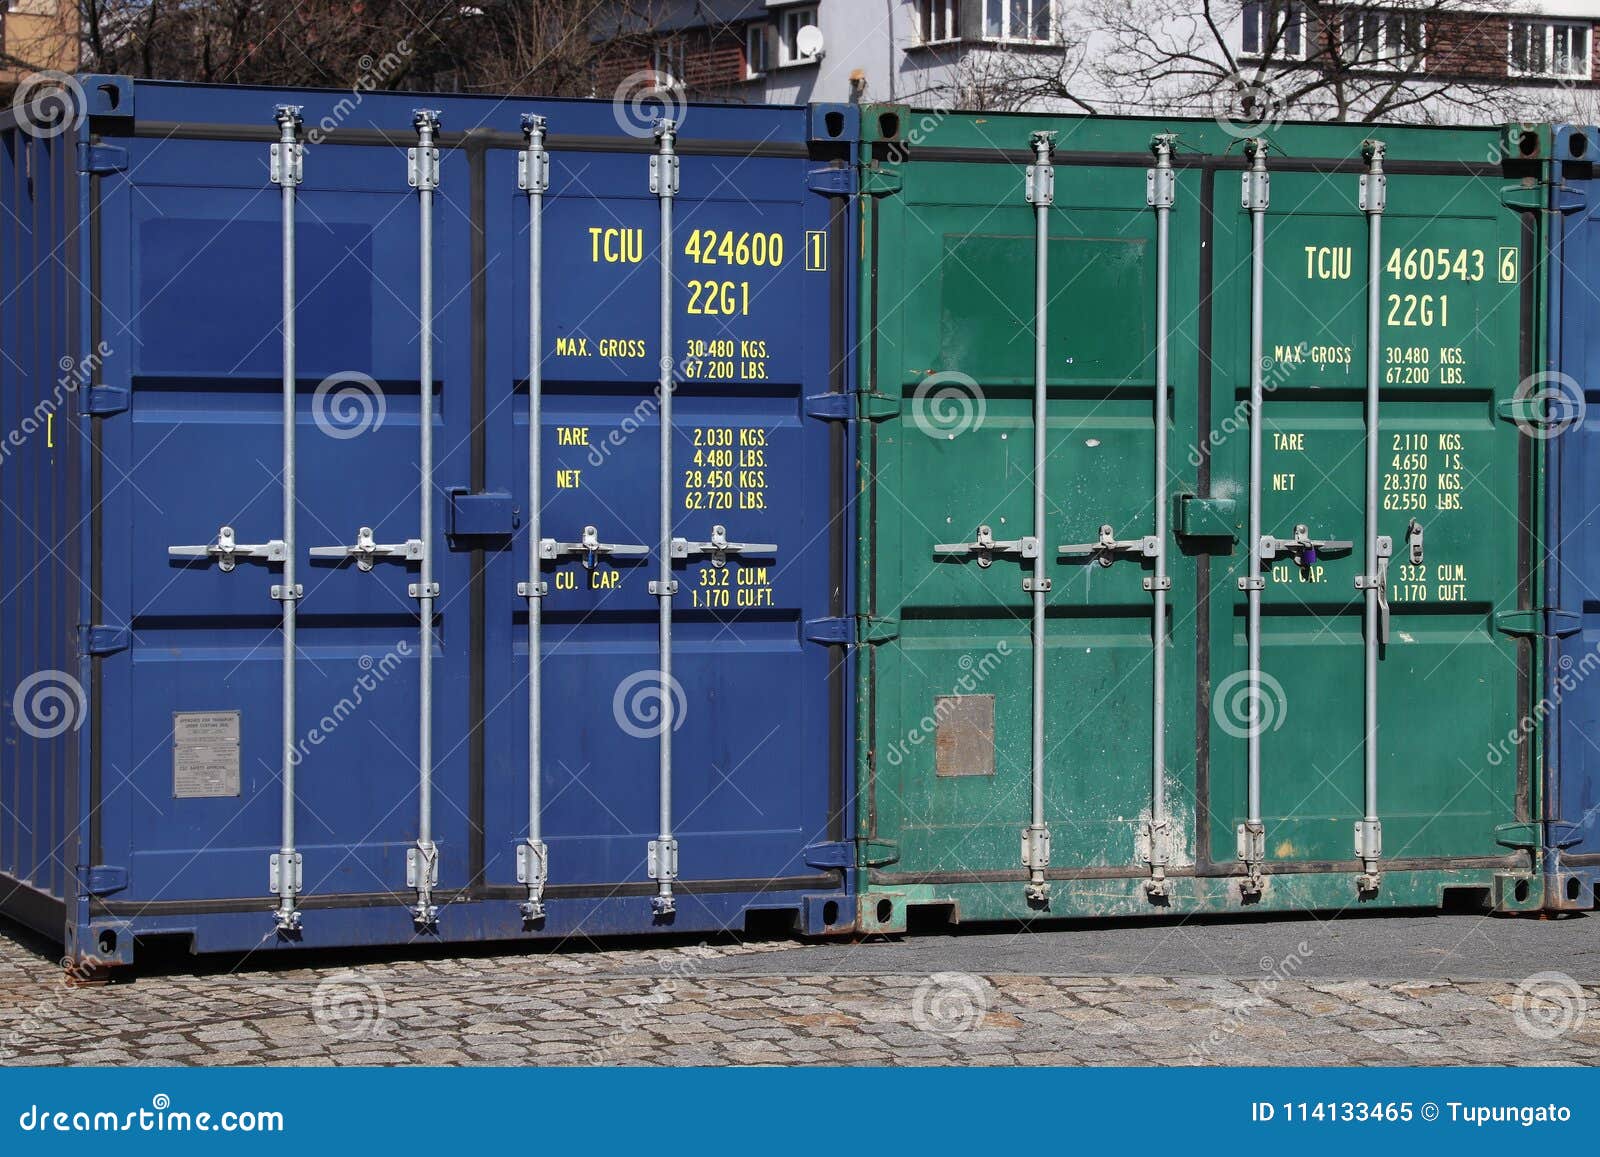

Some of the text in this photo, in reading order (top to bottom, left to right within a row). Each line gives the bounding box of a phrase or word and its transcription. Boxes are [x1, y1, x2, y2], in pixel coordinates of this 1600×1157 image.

[588, 227, 643, 263] TCIU
[684, 229, 784, 267] 424600
[1304, 246, 1516, 281] TCIU 460543 6
[687, 280, 749, 316] 22G1
[1387, 294, 1448, 327] 22G1
[556, 338, 592, 357] MAX.
[599, 339, 646, 358] GROSS
[741, 340, 770, 359] KGS.
[1275, 345, 1306, 364] MAX.
[1311, 346, 1352, 364] GROSS
[1440, 347, 1466, 364] KGS.
[741, 361, 769, 380] LBS.
[1440, 367, 1466, 384] LBS.
[556, 427, 590, 446] TARE
[740, 428, 769, 447] KGS.
[1273, 433, 1305, 451] TARE
[1439, 433, 1464, 451] KGS.
[740, 449, 768, 468] LBS.
[556, 470, 581, 489] NET
[740, 470, 769, 489] KGS.
[1273, 473, 1296, 491] NET
[1438, 473, 1464, 490] KGS.
[740, 491, 768, 510] LBS.
[1438, 493, 1463, 510] LBS.
[555, 567, 771, 590] CU. CAP. 33.2 CU.M.
[1273, 566, 1293, 583] CU.
[1399, 564, 1427, 582] 33.2
[1437, 564, 1467, 582] CU.M.
[736, 588, 775, 607] CU.FT.
